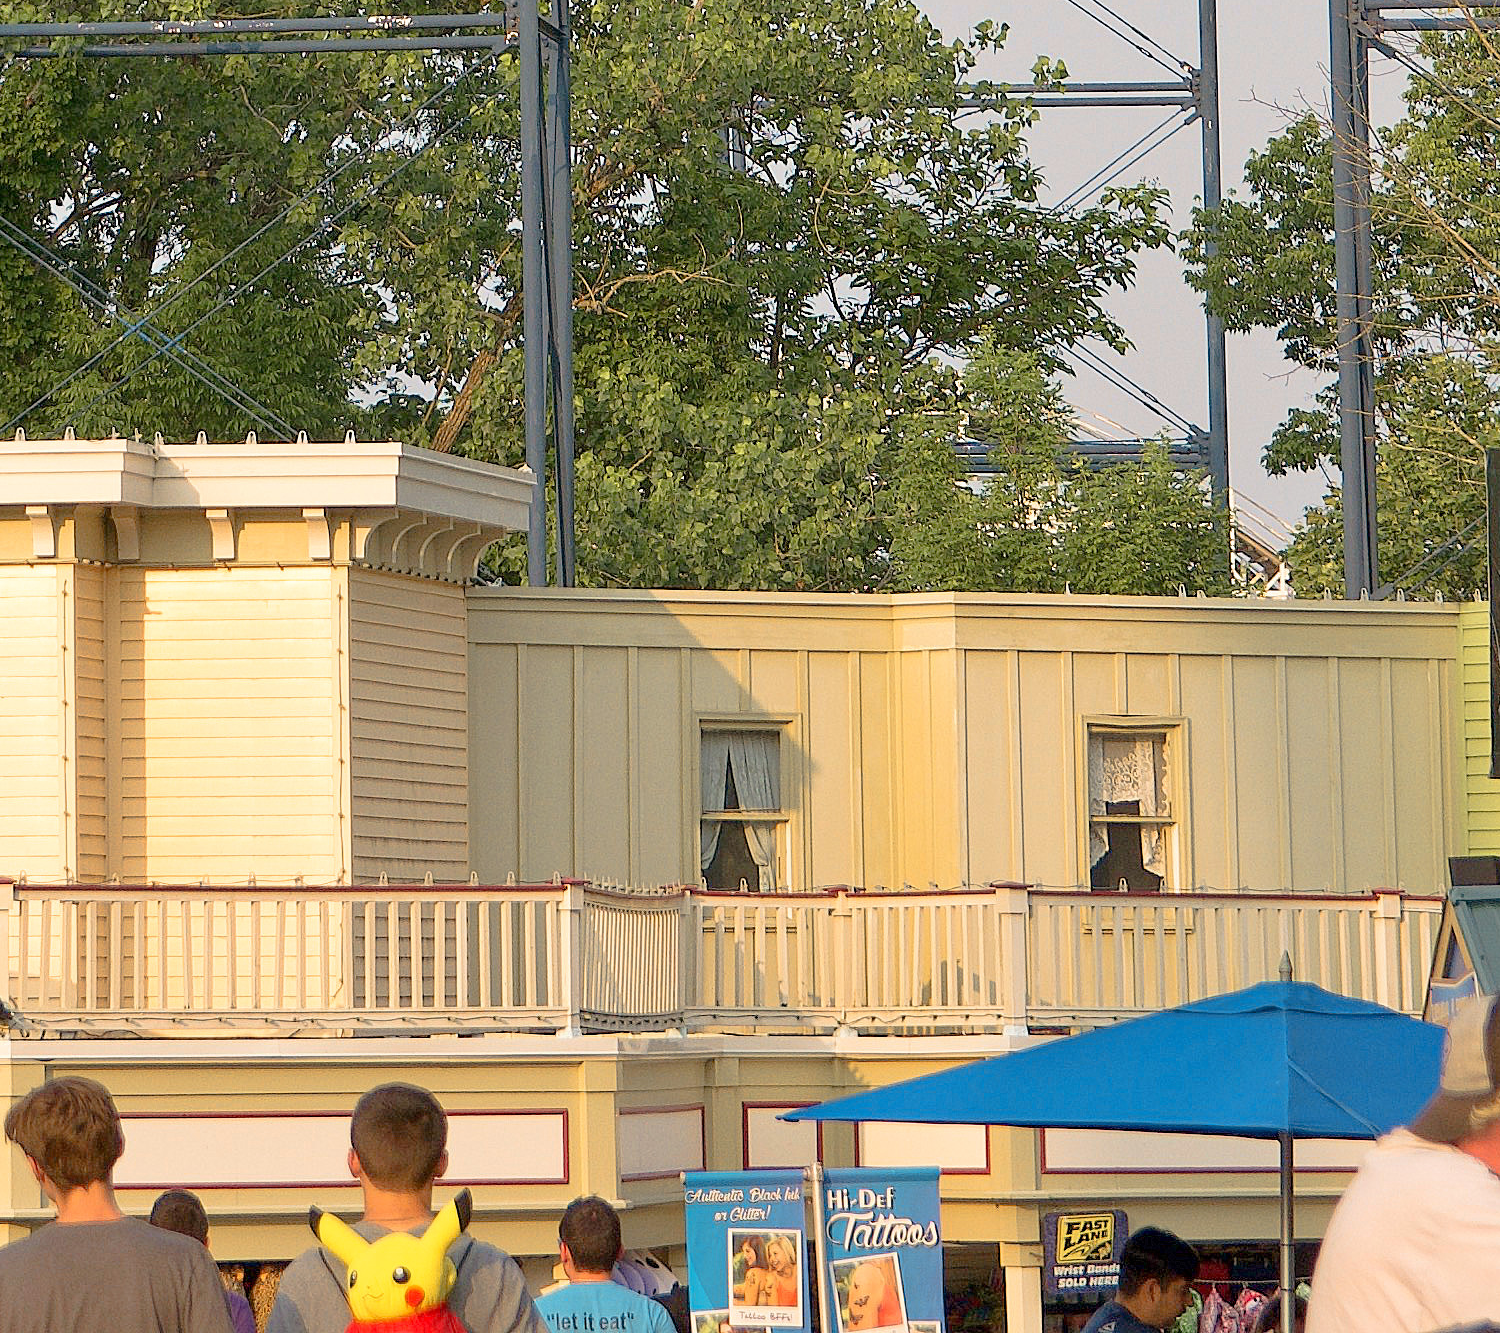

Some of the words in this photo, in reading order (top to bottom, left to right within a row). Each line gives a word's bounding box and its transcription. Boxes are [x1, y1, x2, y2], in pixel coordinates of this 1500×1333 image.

[749, 1187, 782, 1202] Black
[826, 1211, 939, 1251] Tattoos
[1065, 1220, 1109, 1235] FAST
[1064, 1230, 1109, 1250] LANE
[1058, 1277, 1087, 1288] SOLD
[1089, 1275, 1119, 1286] HERE
[583, 1312, 594, 1331] it
